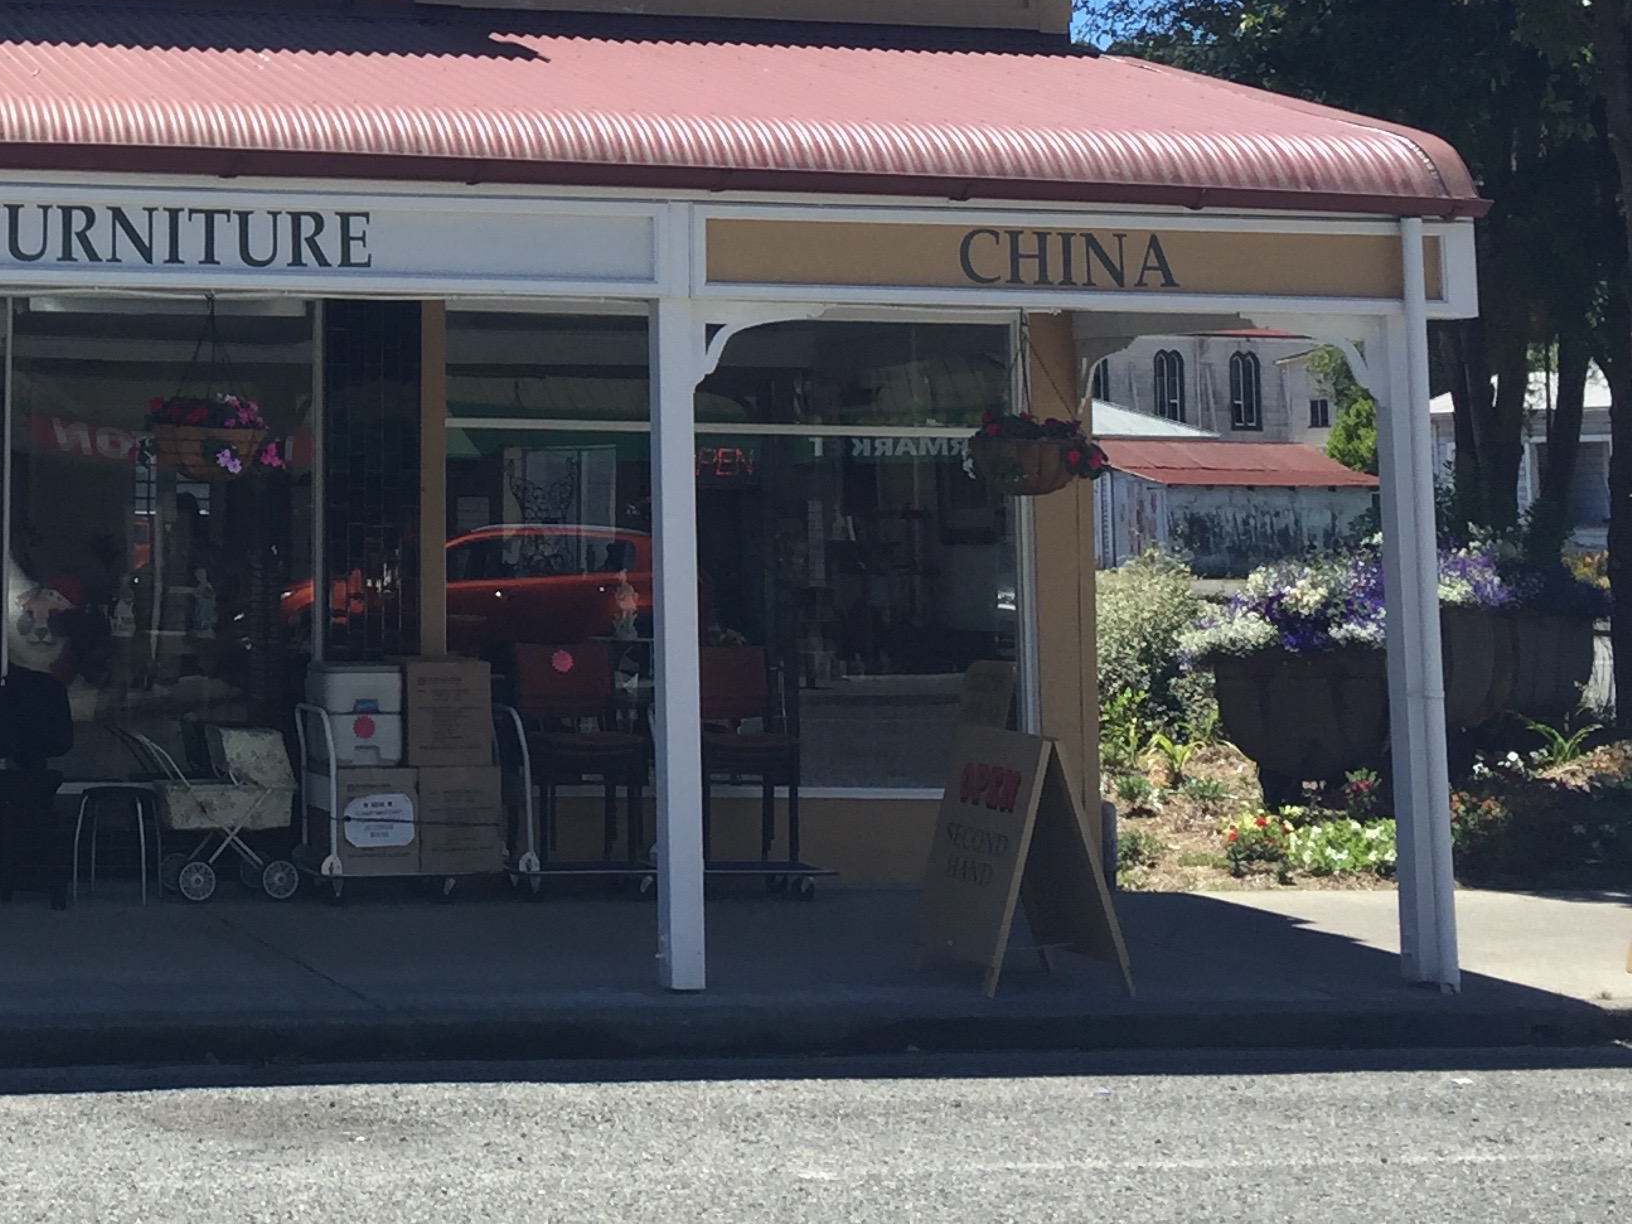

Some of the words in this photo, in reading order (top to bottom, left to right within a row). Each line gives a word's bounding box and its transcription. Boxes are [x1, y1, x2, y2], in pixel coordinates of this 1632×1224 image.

[959, 229, 1180, 289] CHINA
[945, 822, 1009, 857] SECOND
[945, 854, 994, 886] HAND
